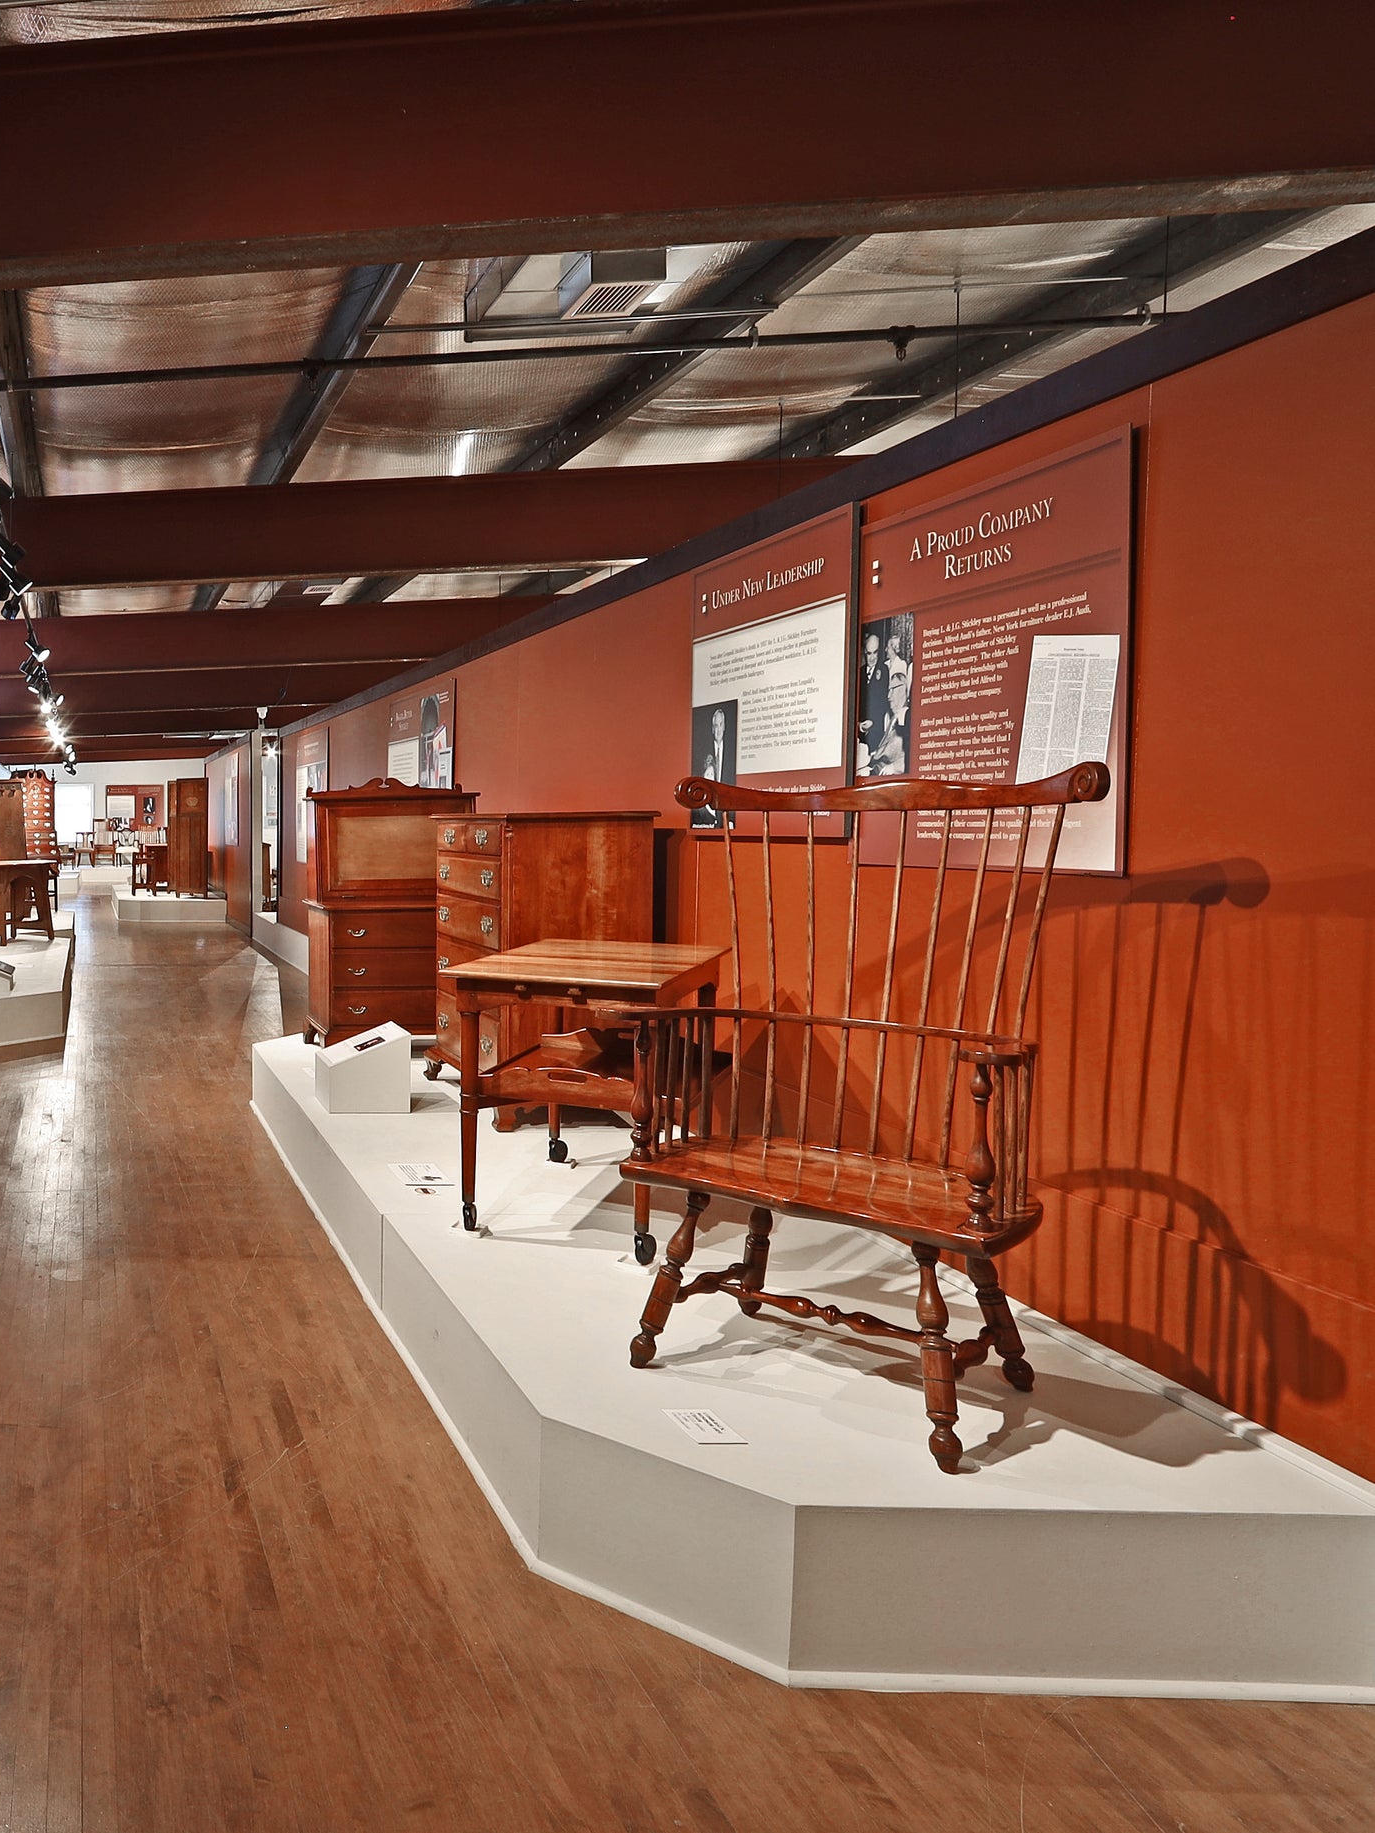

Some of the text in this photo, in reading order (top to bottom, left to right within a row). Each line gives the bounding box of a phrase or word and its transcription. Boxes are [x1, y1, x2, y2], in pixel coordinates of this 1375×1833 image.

[909, 537, 922, 562] A
[940, 625, 946, 634] L.
[945, 624, 951, 632] &
[951, 622, 962, 632] J.G.
[961, 617, 982, 629] Stickley
[996, 607, 1020, 623] personal
[1028, 603, 1040, 613] well
[1051, 591, 1088, 610] professional
[944, 633, 960, 644] Alfred
[993, 624, 1006, 634] New
[1005, 619, 1019, 631] York
[1019, 617, 1045, 629] furniture
[1044, 612, 1063, 622] dealer
[1063, 608, 1075, 619] E.J.
[1075, 604, 1092, 616] Audi,
